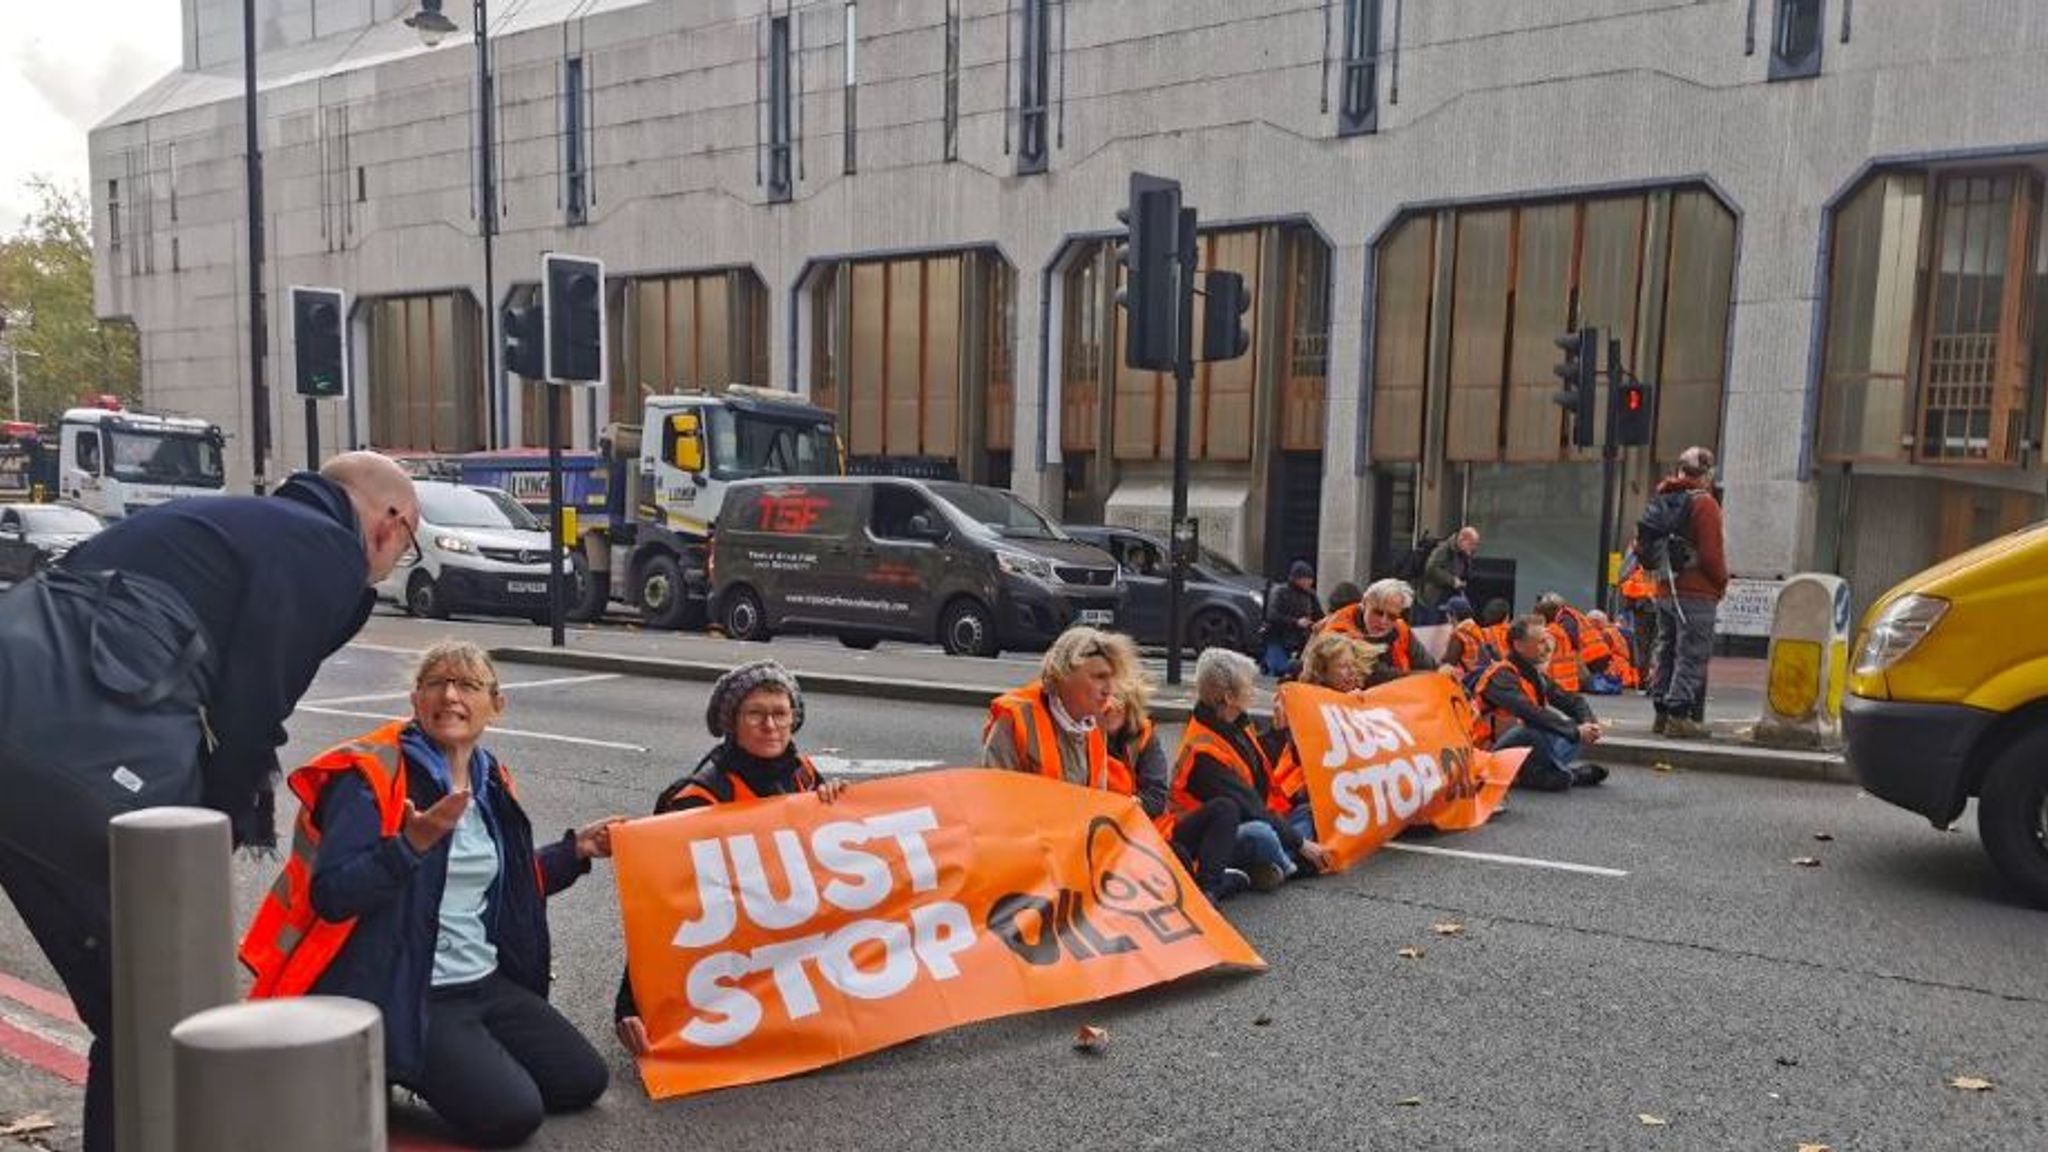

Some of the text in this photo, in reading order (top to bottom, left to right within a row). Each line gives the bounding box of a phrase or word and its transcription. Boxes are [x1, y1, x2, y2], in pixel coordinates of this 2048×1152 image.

[1320, 703, 1417, 768] JUST
[1331, 753, 1443, 837] STOP
[671, 806, 938, 949] JUST
[680, 889, 1138, 1048] STOP OIL
